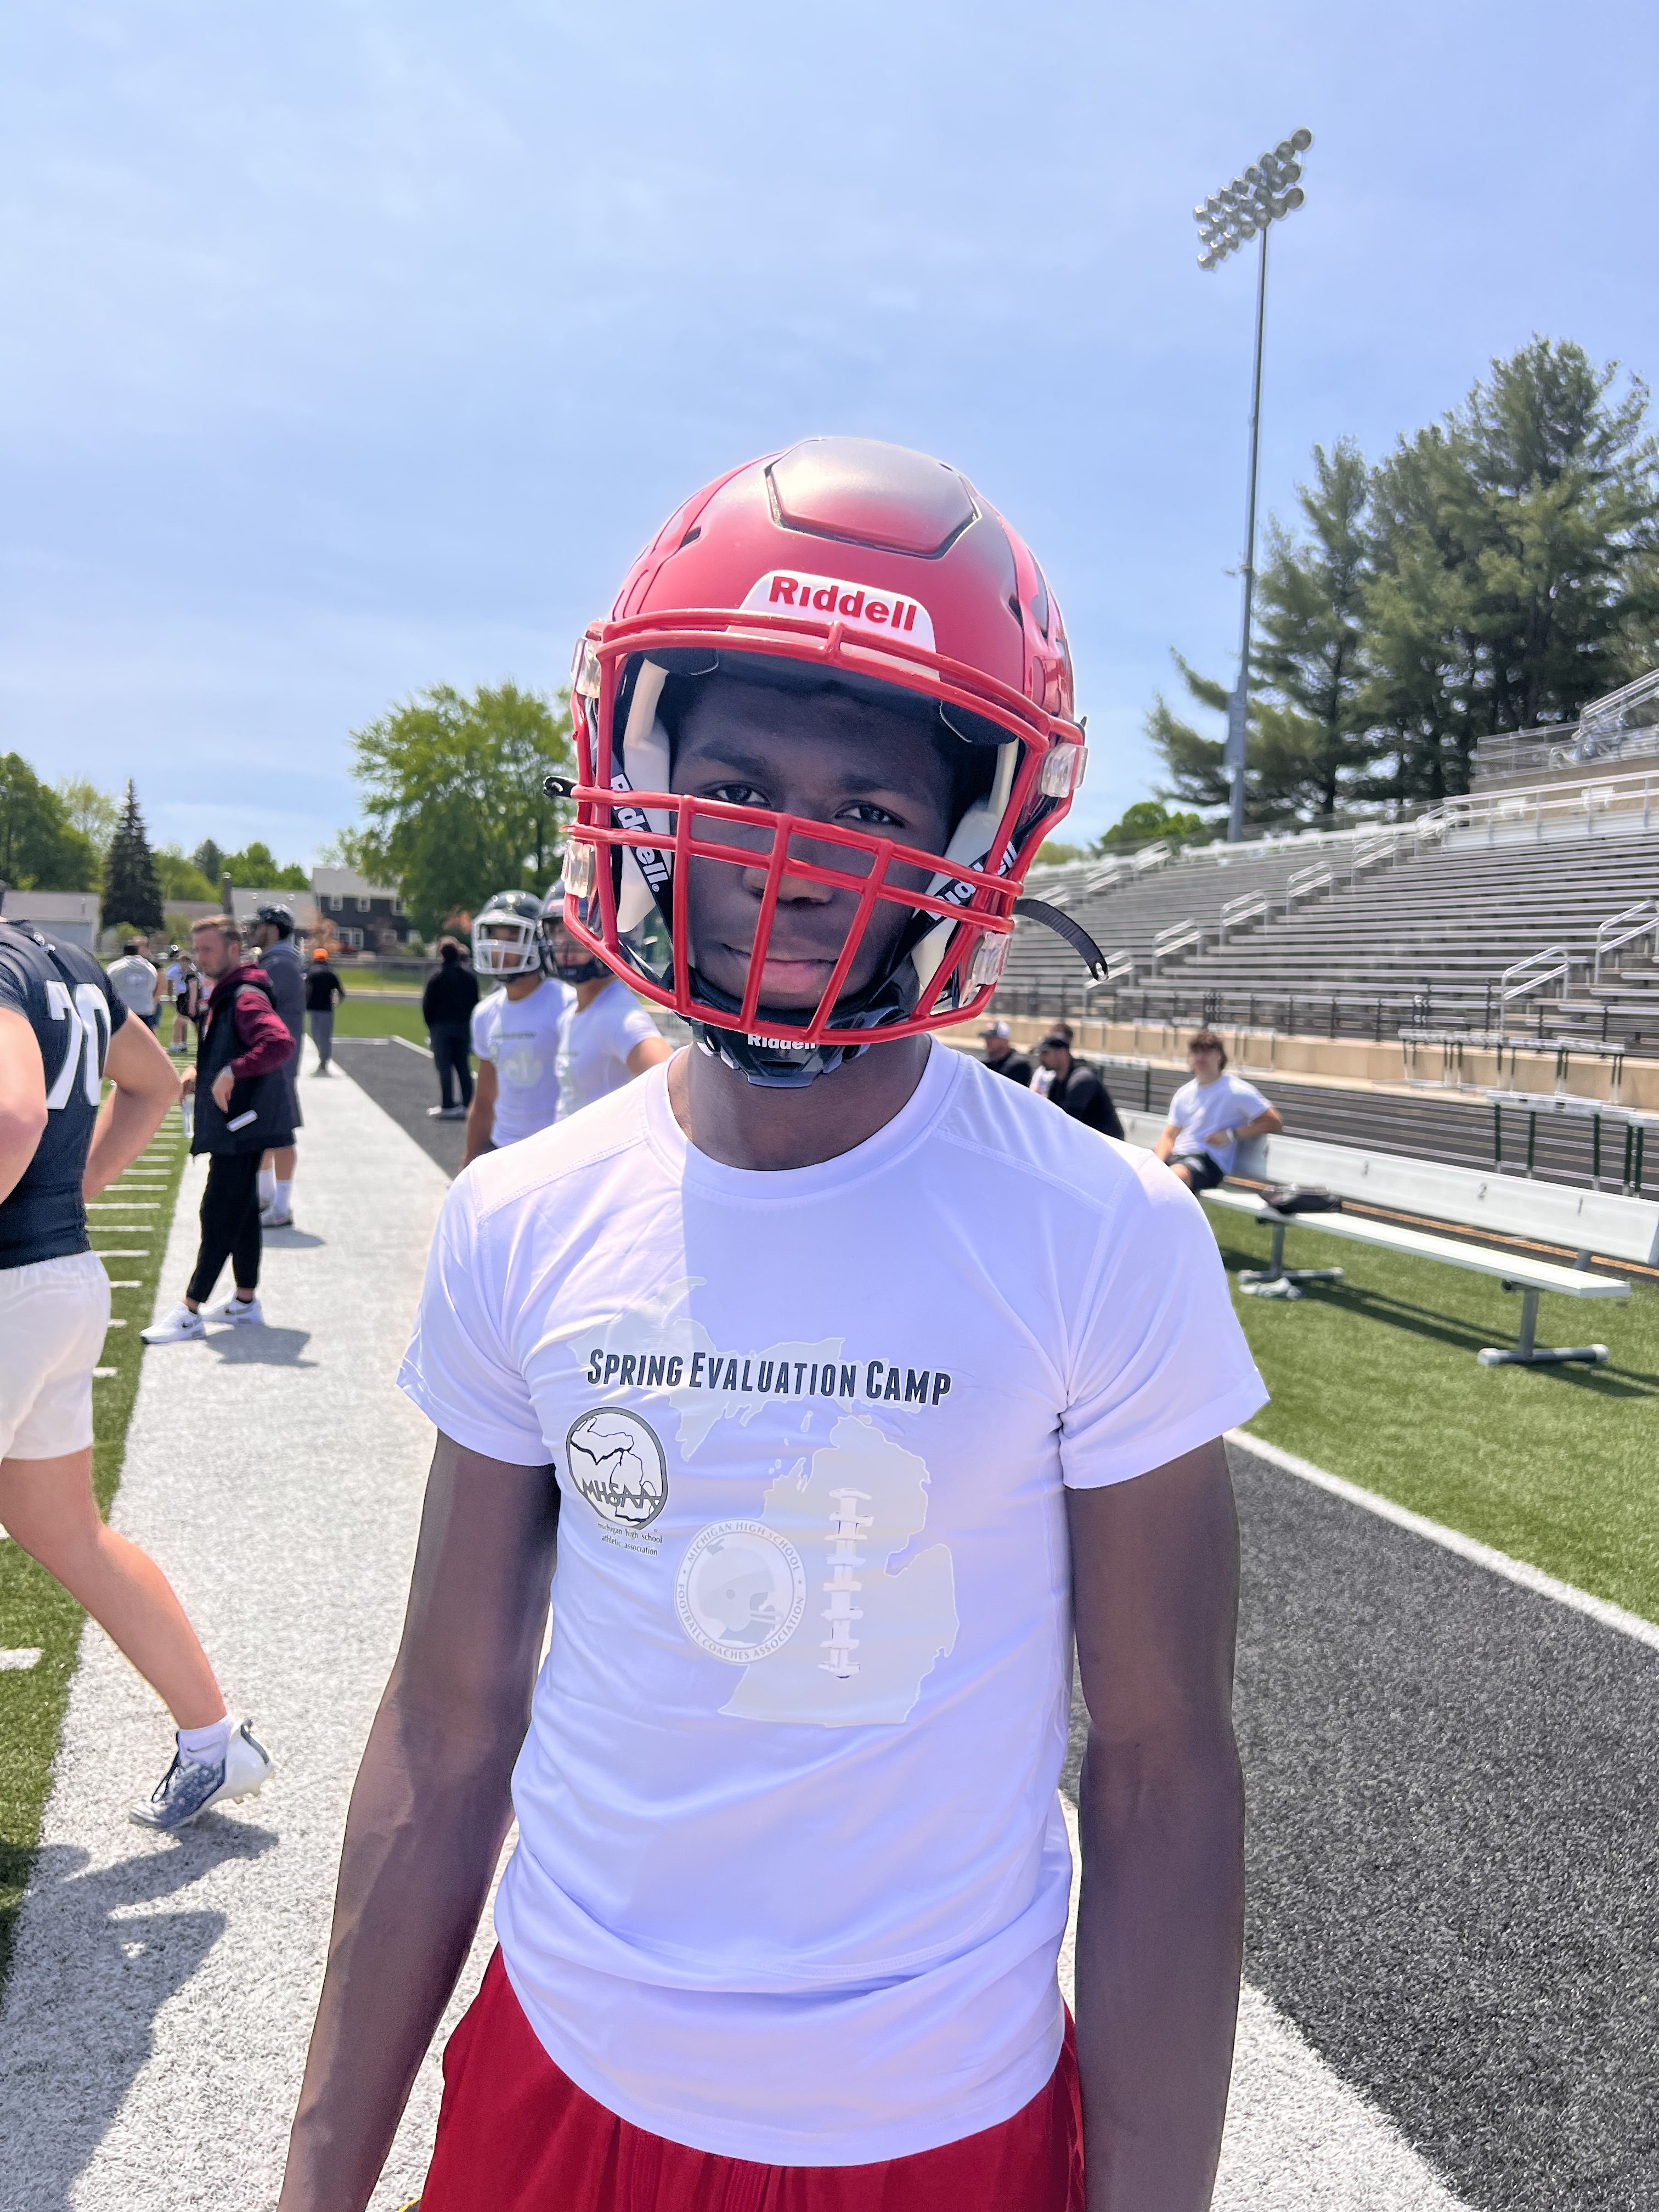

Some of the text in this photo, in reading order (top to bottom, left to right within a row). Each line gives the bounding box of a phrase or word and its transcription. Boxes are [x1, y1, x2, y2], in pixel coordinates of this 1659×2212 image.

[769, 576, 917, 631] Riddell
[610, 774, 669, 884] Rdell
[46, 979, 111, 1110] 70
[1477, 1181, 1488, 1202] 2
[587, 1349, 951, 1406] SPRING EVALUATION CAMP
[582, 1477, 662, 1510] MHSAA
[597, 1523, 662, 1543] michigan high school
[602, 1534, 658, 1556] athletic association
[687, 1522, 800, 1572] MICHIGAN HIGH SCHOOL
[678, 1584, 805, 1660] FOOTBALL COACHES ASSOCIATION
